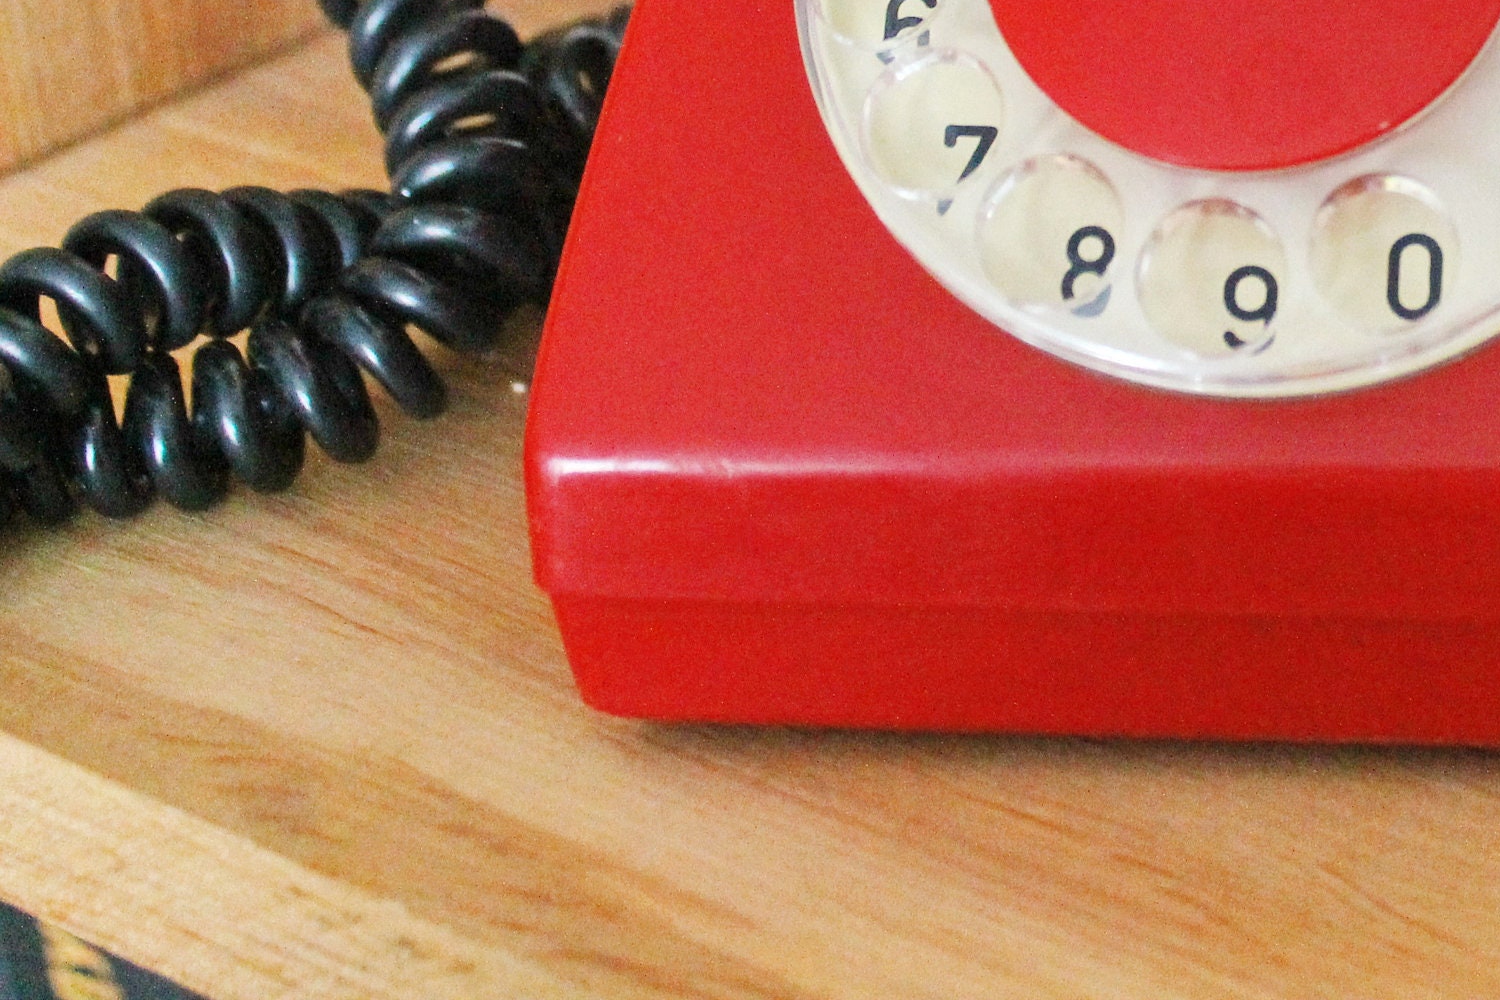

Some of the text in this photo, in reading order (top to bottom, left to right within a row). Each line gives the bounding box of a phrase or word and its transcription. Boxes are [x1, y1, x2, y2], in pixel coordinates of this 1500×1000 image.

[936, 125, 998, 216] 7
[1061, 225, 1116, 317] 8
[1223, 265, 1279, 354] 9
[1386, 232, 1443, 321] 0
